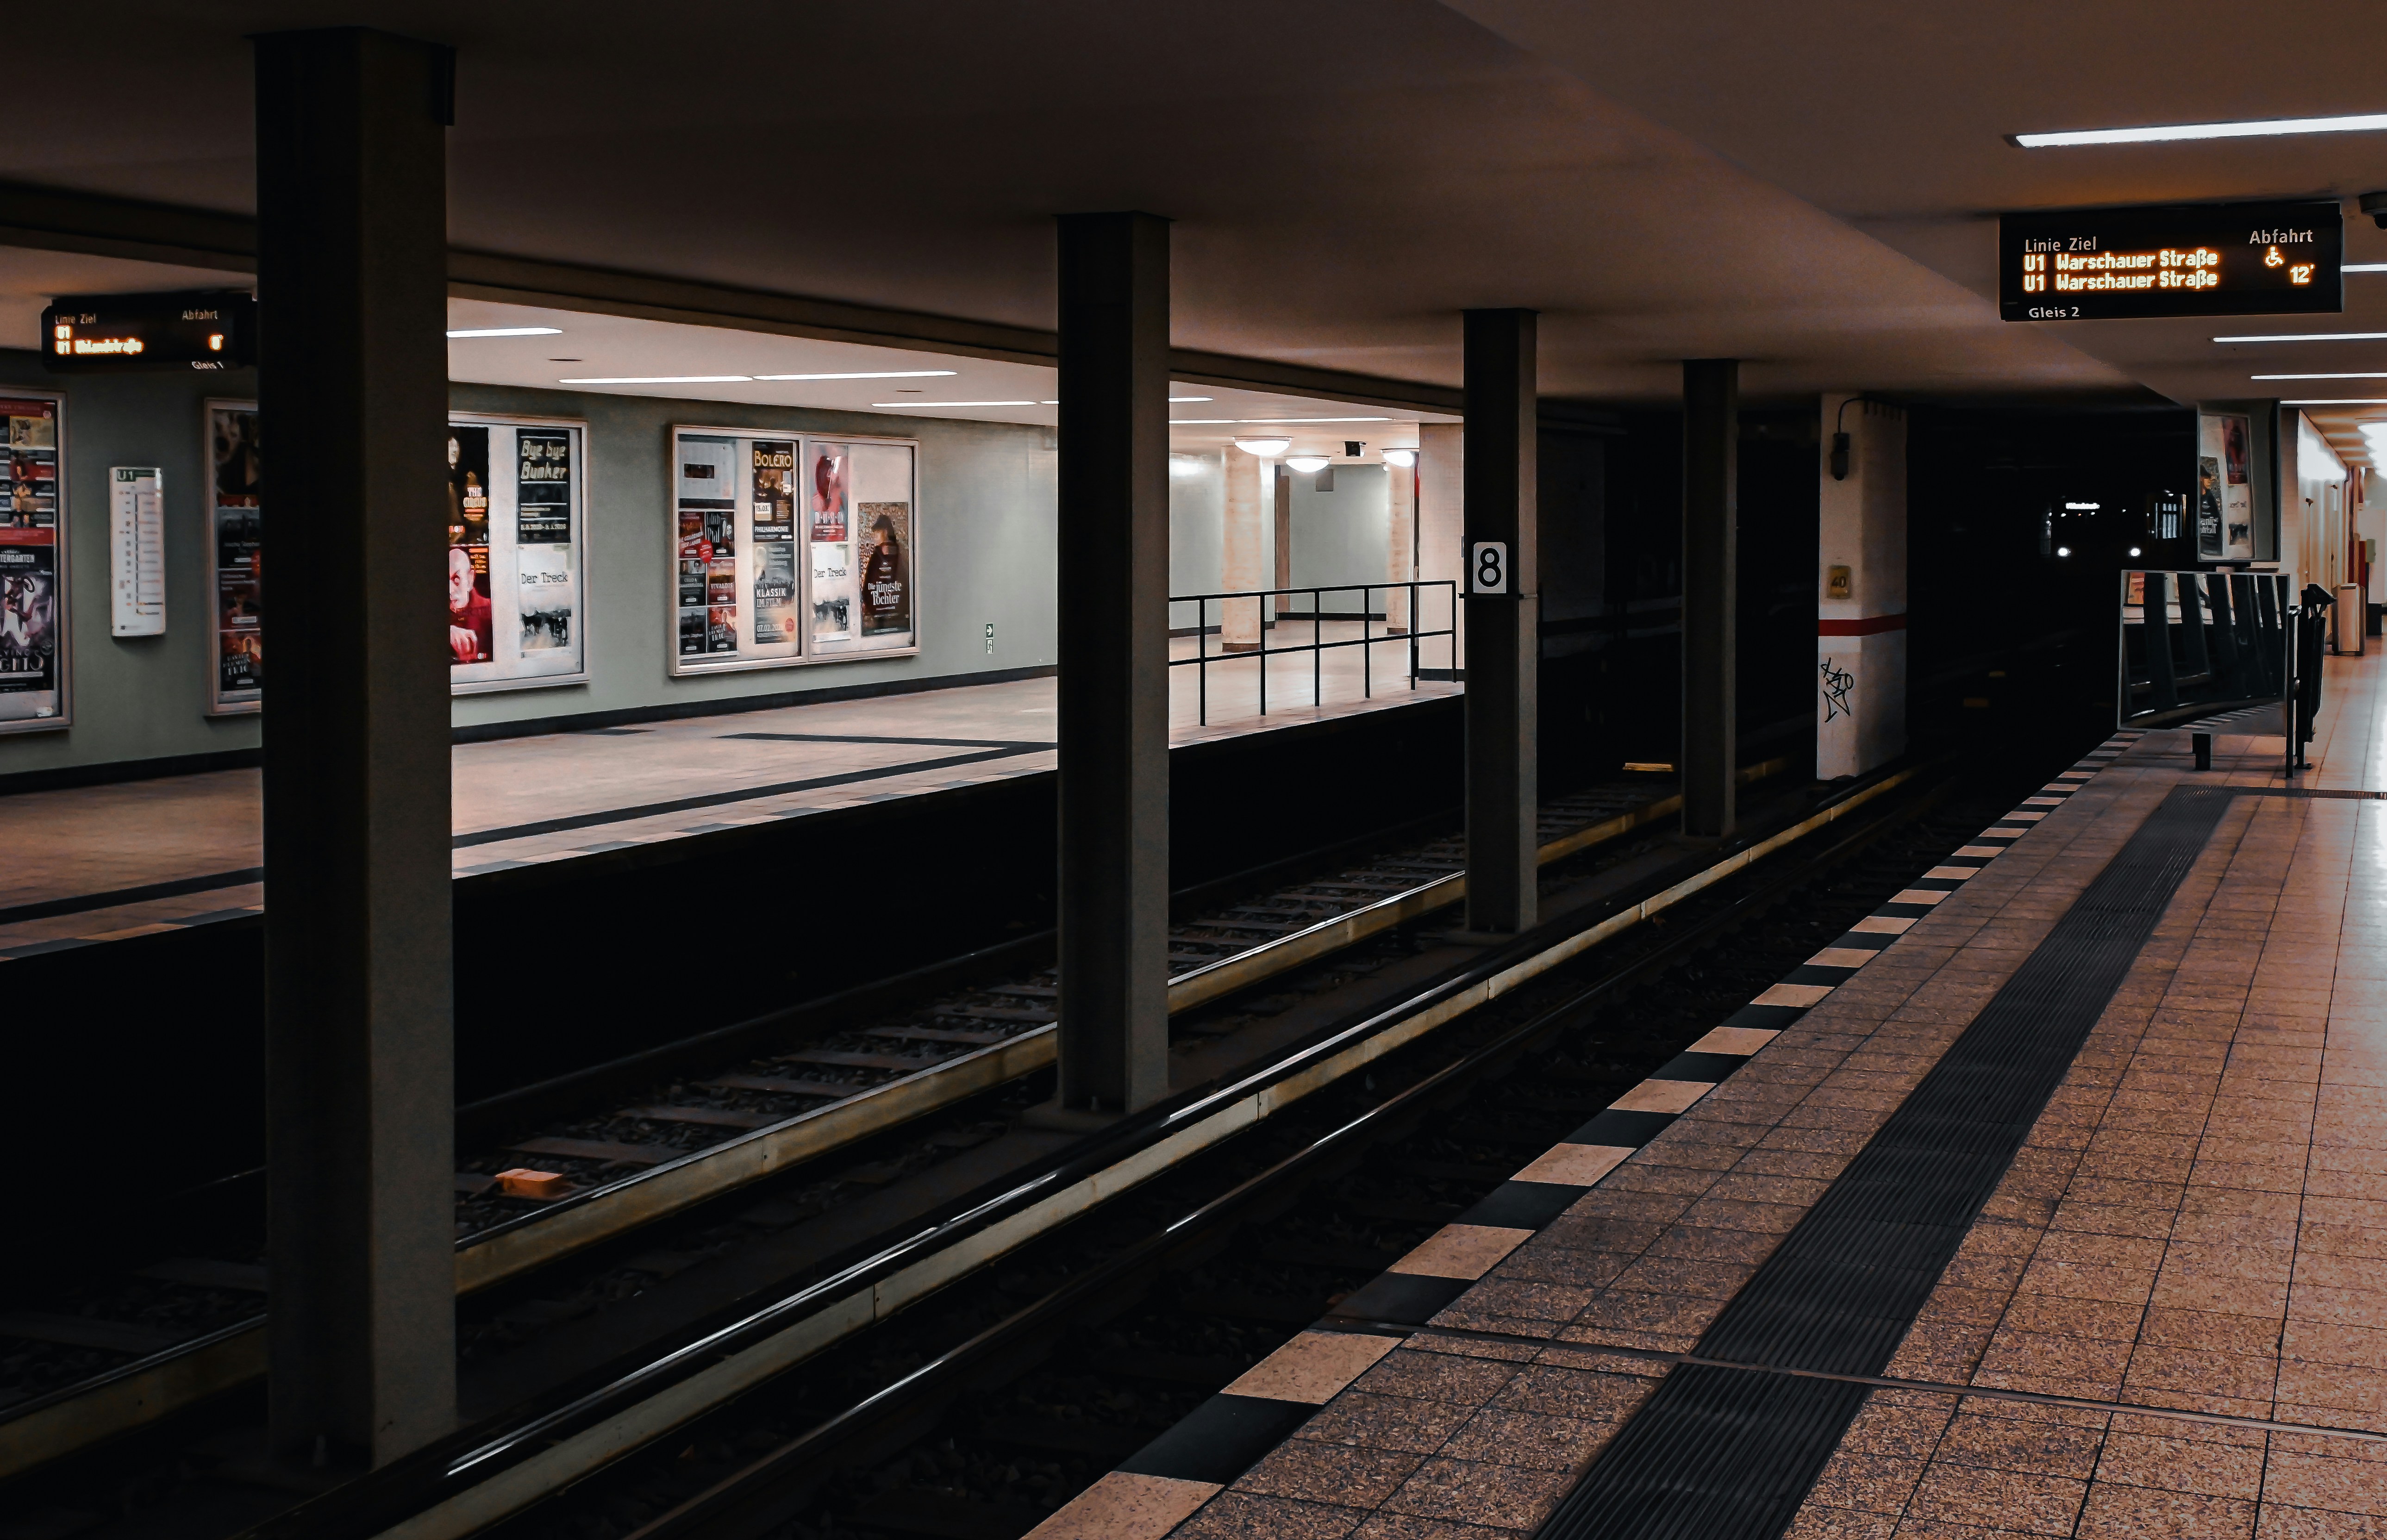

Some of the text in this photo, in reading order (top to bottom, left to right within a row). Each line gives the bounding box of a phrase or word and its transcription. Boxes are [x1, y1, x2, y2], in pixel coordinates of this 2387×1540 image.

[2025, 236, 2096, 252] Linie Ziel
[2249, 229, 2313, 244] Abfahrt
[2024, 248, 2218, 272] U1 Warschauer Straße
[2024, 269, 2218, 292] U1 Warschauer Straße
[80, 313, 96, 324] Ziel
[182, 309, 218, 320] Abfahrt
[2029, 306, 2080, 318] Gleis 2
[192, 361, 217, 369] Gleis
[521, 440, 566, 460] Bye bye
[754, 450, 792, 467] BOLERO
[117, 470, 133, 481] U1
[520, 461, 566, 479] Bunker
[813, 567, 846, 578] Der Treck
[1477, 547, 1502, 588] 8
[521, 571, 568, 584] Der Treck
[1831, 576, 1847, 588] 40
[756, 588, 787, 598] KLASSIK
[876, 580, 902, 597] jüngste
[871, 590, 900, 605] Tochter
